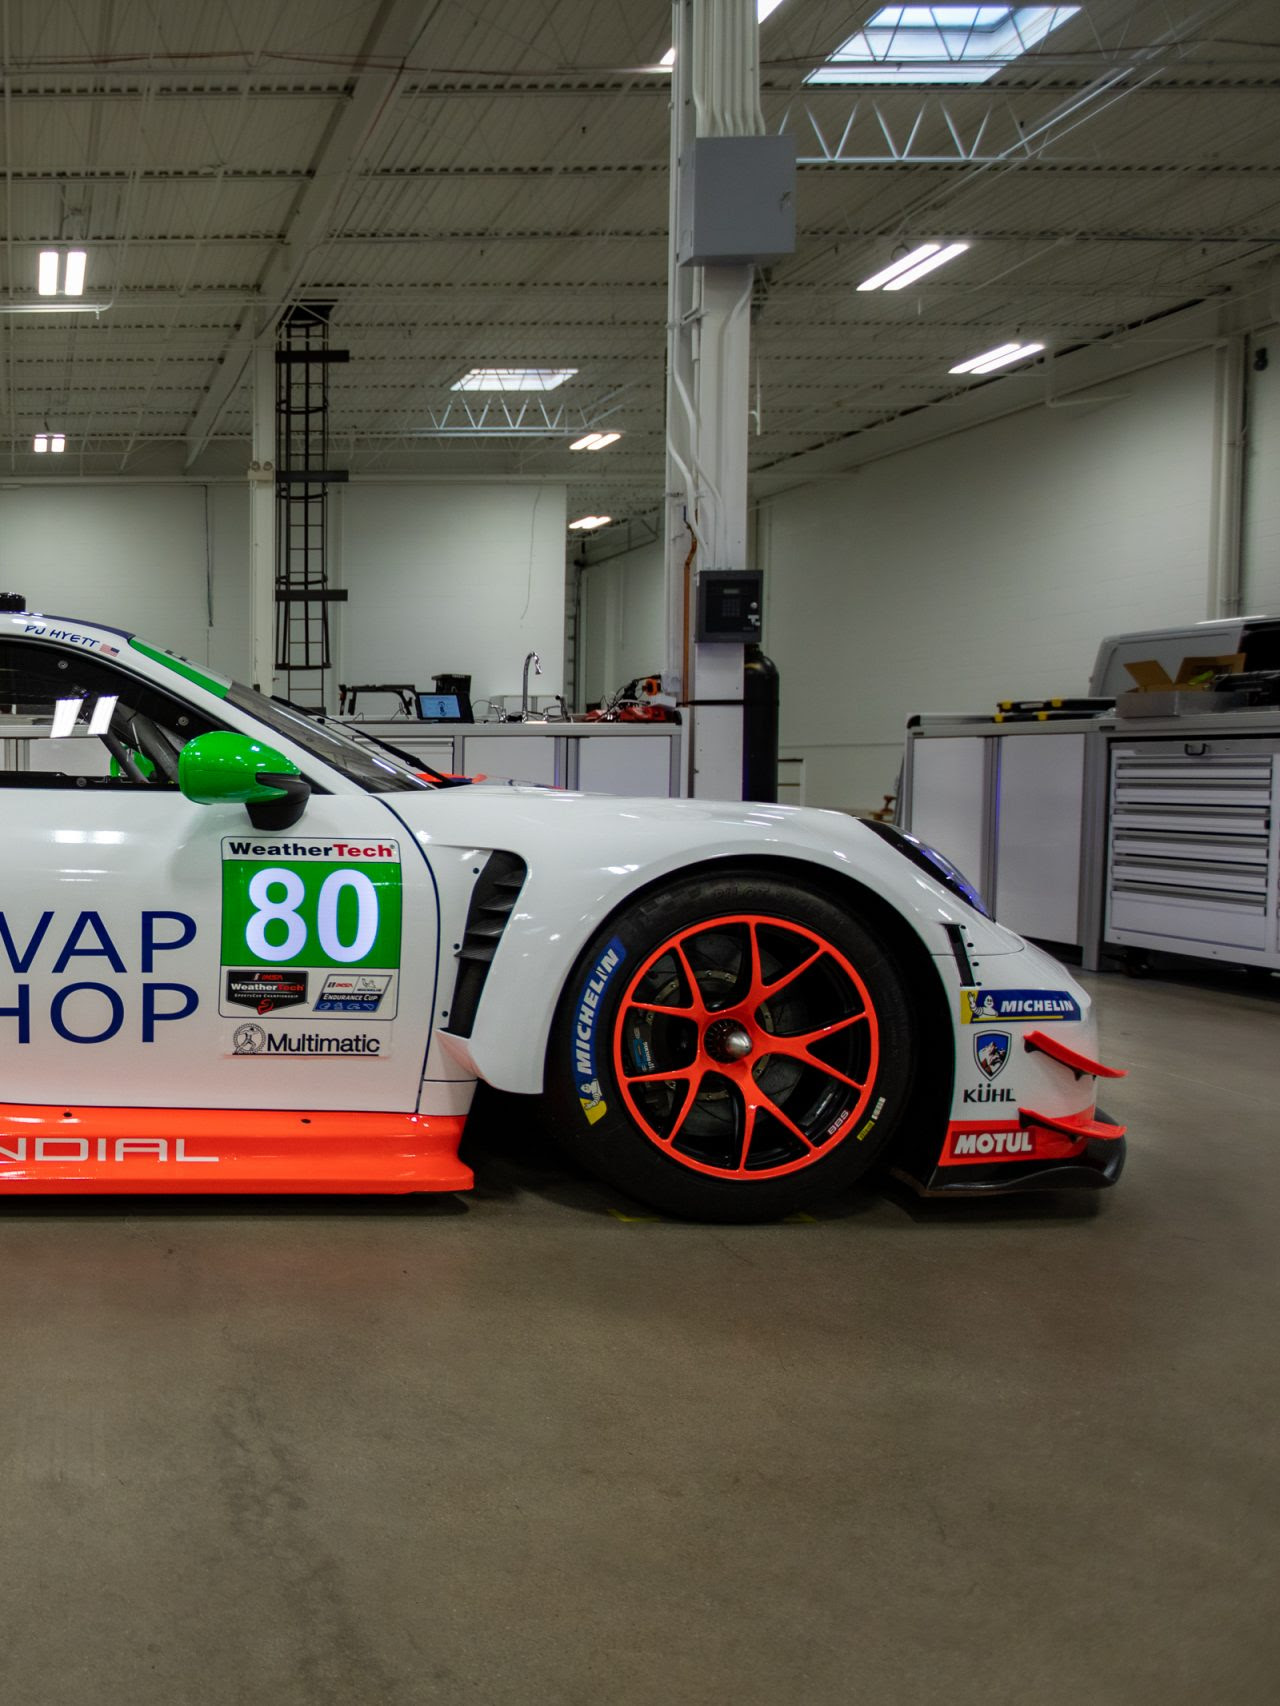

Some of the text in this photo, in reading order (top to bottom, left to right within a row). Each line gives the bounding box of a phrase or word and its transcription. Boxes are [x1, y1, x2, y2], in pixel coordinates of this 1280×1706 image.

[24, 625, 100, 648] PJ HYETT
[229, 841, 394, 858] WeatherTech
[245, 867, 380, 963] 80
[576, 947, 620, 1075] MICHELIN
[1000, 999, 1074, 1013] MICHELIN
[267, 1032, 380, 1053] Multimatic
[963, 1083, 1016, 1103] KÜHL
[954, 1131, 1033, 1155] MOTUL
